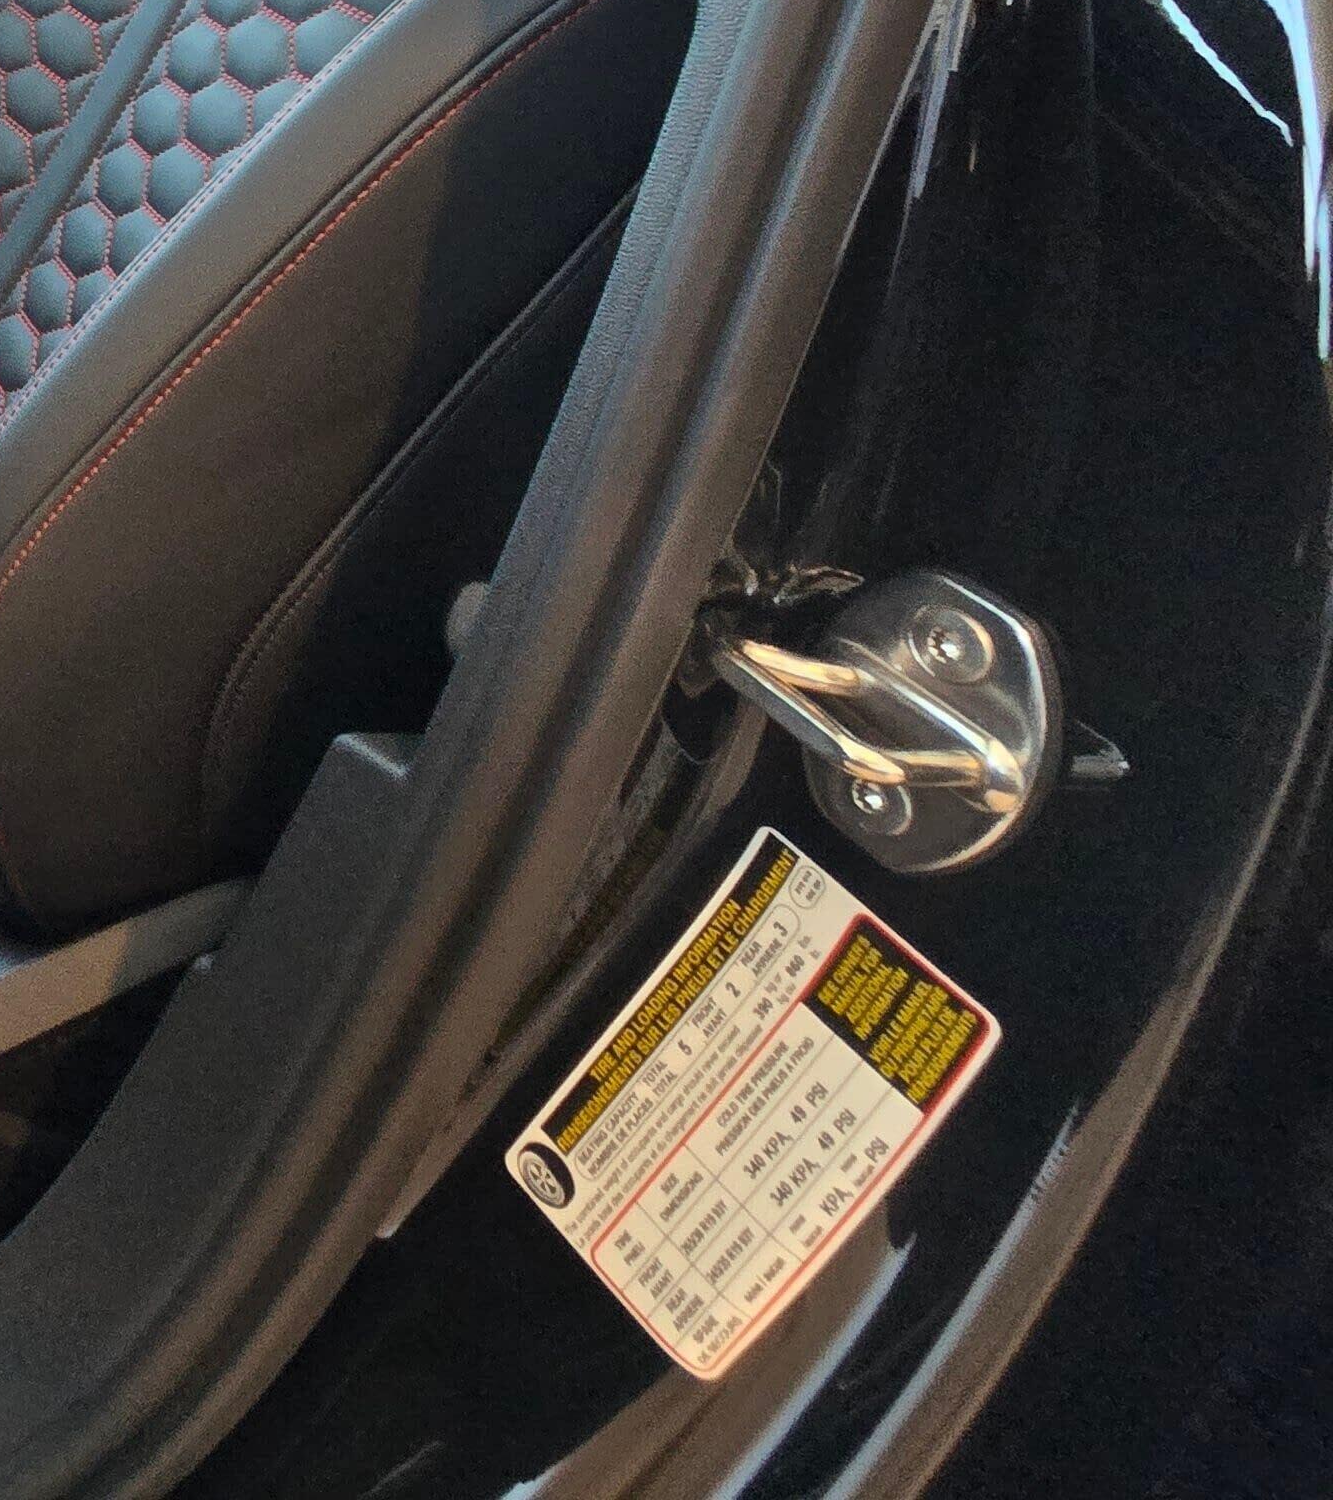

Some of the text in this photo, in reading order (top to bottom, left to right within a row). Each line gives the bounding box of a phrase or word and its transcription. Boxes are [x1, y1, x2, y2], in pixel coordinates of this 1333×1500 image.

[739, 940, 762, 967] REAR
[772, 920, 789, 937] 3
[555, 848, 796, 1152] RENSEIGNEMENTS SUR LES PNEUS ET LE CHARGEMENT
[589, 897, 741, 1084] TIRE AND LOADING INFORMATION
[690, 995, 718, 1028] FRONT
[723, 980, 741, 998] 2
[828, 946, 884, 1015] MANUAL FOR
[853, 966, 910, 1041] INFORMATION
[675, 1038, 694, 1057] 5
[701, 1007, 727, 1038] AVANT
[897, 1005, 959, 1083] POUR PLUS DE
[604, 1090, 640, 1133] CAPACITY
[641, 1057, 667, 1088] TOTAL
[624, 1096, 654, 1132] PLACES
[651, 1068, 677, 1098] TOTAL
[734, 1082, 755, 1105] TIRE
[749, 1039, 789, 1087] PRESSURE
[715, 1112, 752, 1156] PRESSION
[741, 1151, 767, 1181] 340
[786, 1103, 808, 1126] 49
[804, 1080, 829, 1108] PSI
[768, 1178, 795, 1208] 340
[814, 1129, 836, 1153] 49
[831, 1106, 857, 1135] PSI
[862, 1134, 890, 1164] PSI
